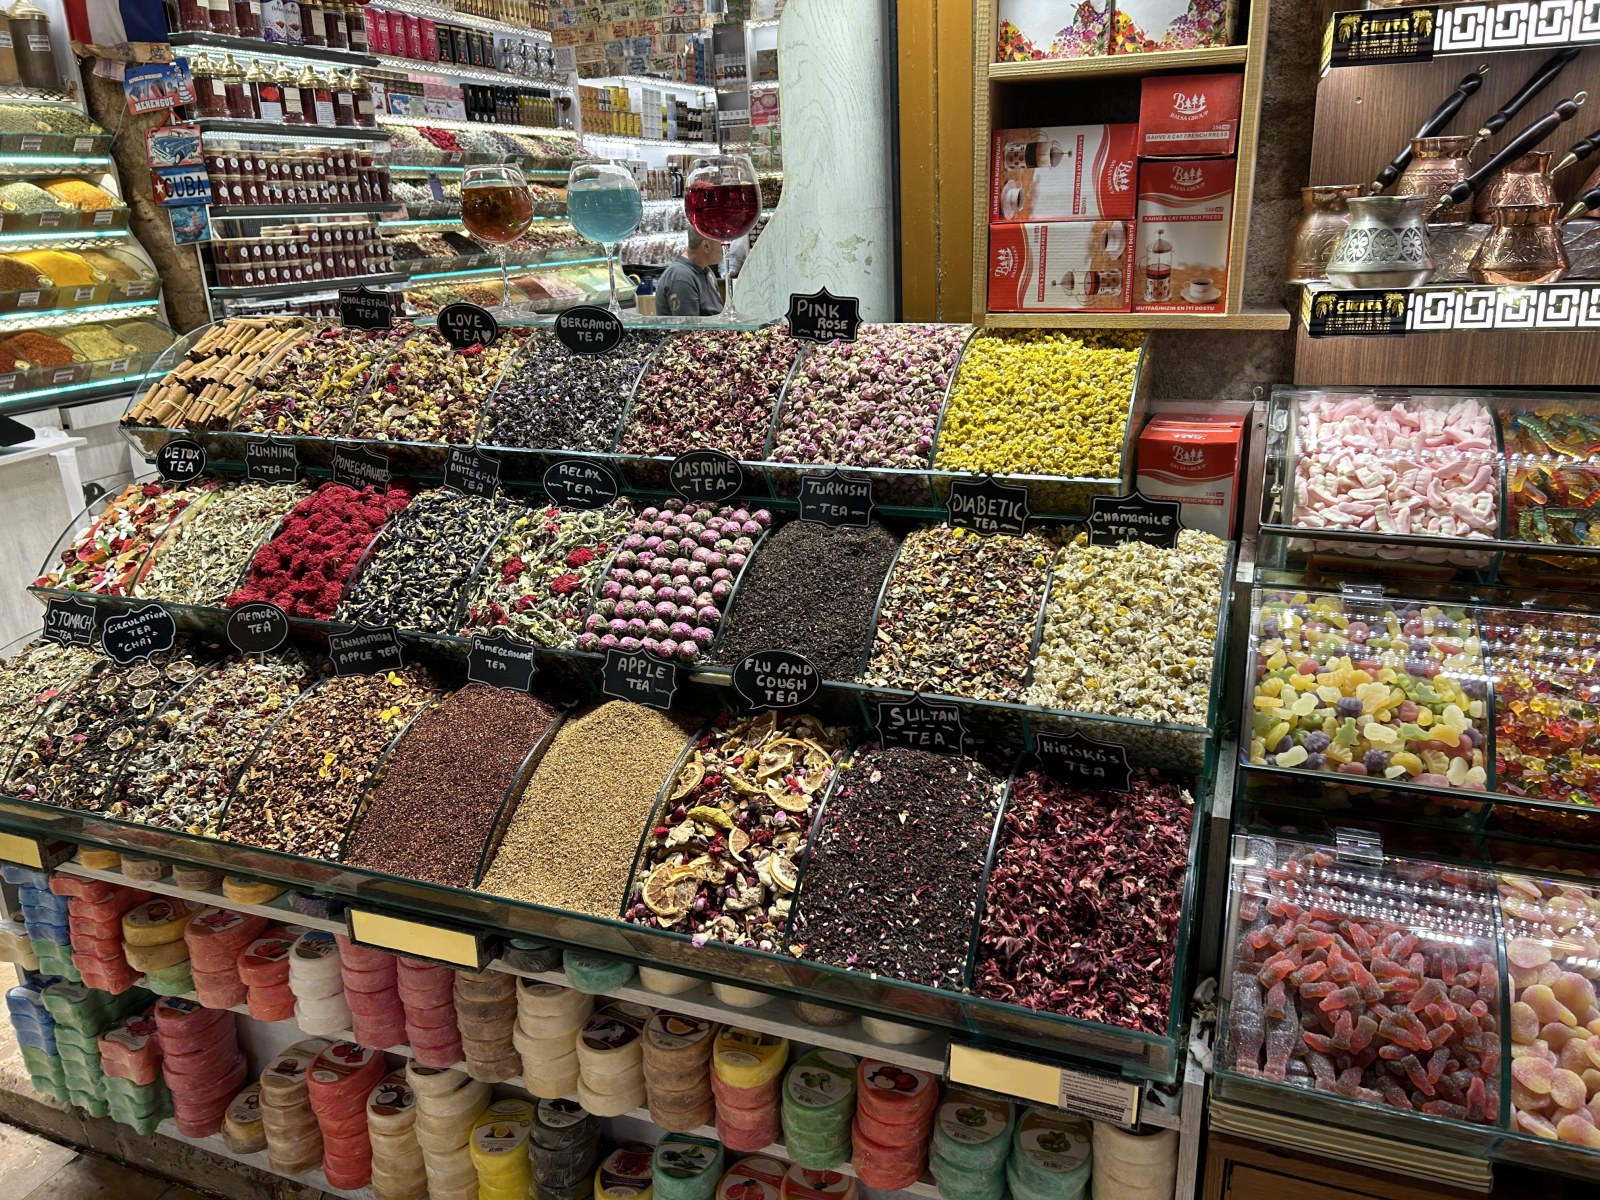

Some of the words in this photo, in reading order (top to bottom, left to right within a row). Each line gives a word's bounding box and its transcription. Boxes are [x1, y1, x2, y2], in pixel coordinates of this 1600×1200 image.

[134, 97, 175, 112] MERENGUE
[164, 175, 206, 198] CUBA
[356, 308, 379, 320] TEA
[797, 299, 840, 319] PINK
[446, 313, 483, 328] LOVE
[560, 316, 617, 331] BERGAMOT
[817, 317, 848, 330] ROSE
[453, 328, 481, 341] TEA
[577, 331, 604, 342] TEA
[813, 330, 833, 339] TEA
[164, 446, 200, 460] DETOX
[452, 450, 479, 468] BLUE
[170, 460, 194, 472] TEA
[261, 465, 281, 475] TEA
[559, 464, 602, 482] RELAX
[674, 458, 735, 479] JASMINE
[350, 475, 366, 487] TEA
[450, 462, 497, 486] BUTTERFLY
[462, 477, 484, 492] TEA
[563, 480, 593, 495] TEA
[690, 478, 726, 493] TEA
[807, 481, 868, 497] TURKISH
[820, 503, 848, 517] TEA
[952, 493, 1023, 521] DIABETIC
[973, 516, 999, 530] TEA
[48, 609, 93, 630] STOMACH
[248, 620, 272, 634] TEA
[59, 629, 72, 640] TEA
[128, 624, 151, 637] TEA
[340, 651, 373, 664] APPLE
[377, 645, 399, 658] TEA
[485, 659, 507, 671] TEA
[617, 656, 667, 679] APPLE
[744, 658, 771, 673] FLU
[777, 662, 813, 676] AND
[626, 677, 650, 693] TEA
[756, 674, 807, 690] COUGH
[764, 689, 798, 703] TEA
[890, 707, 957, 726] SULTAN
[902, 730, 945, 745] TEA
[1064, 760, 1105, 777] TEA
